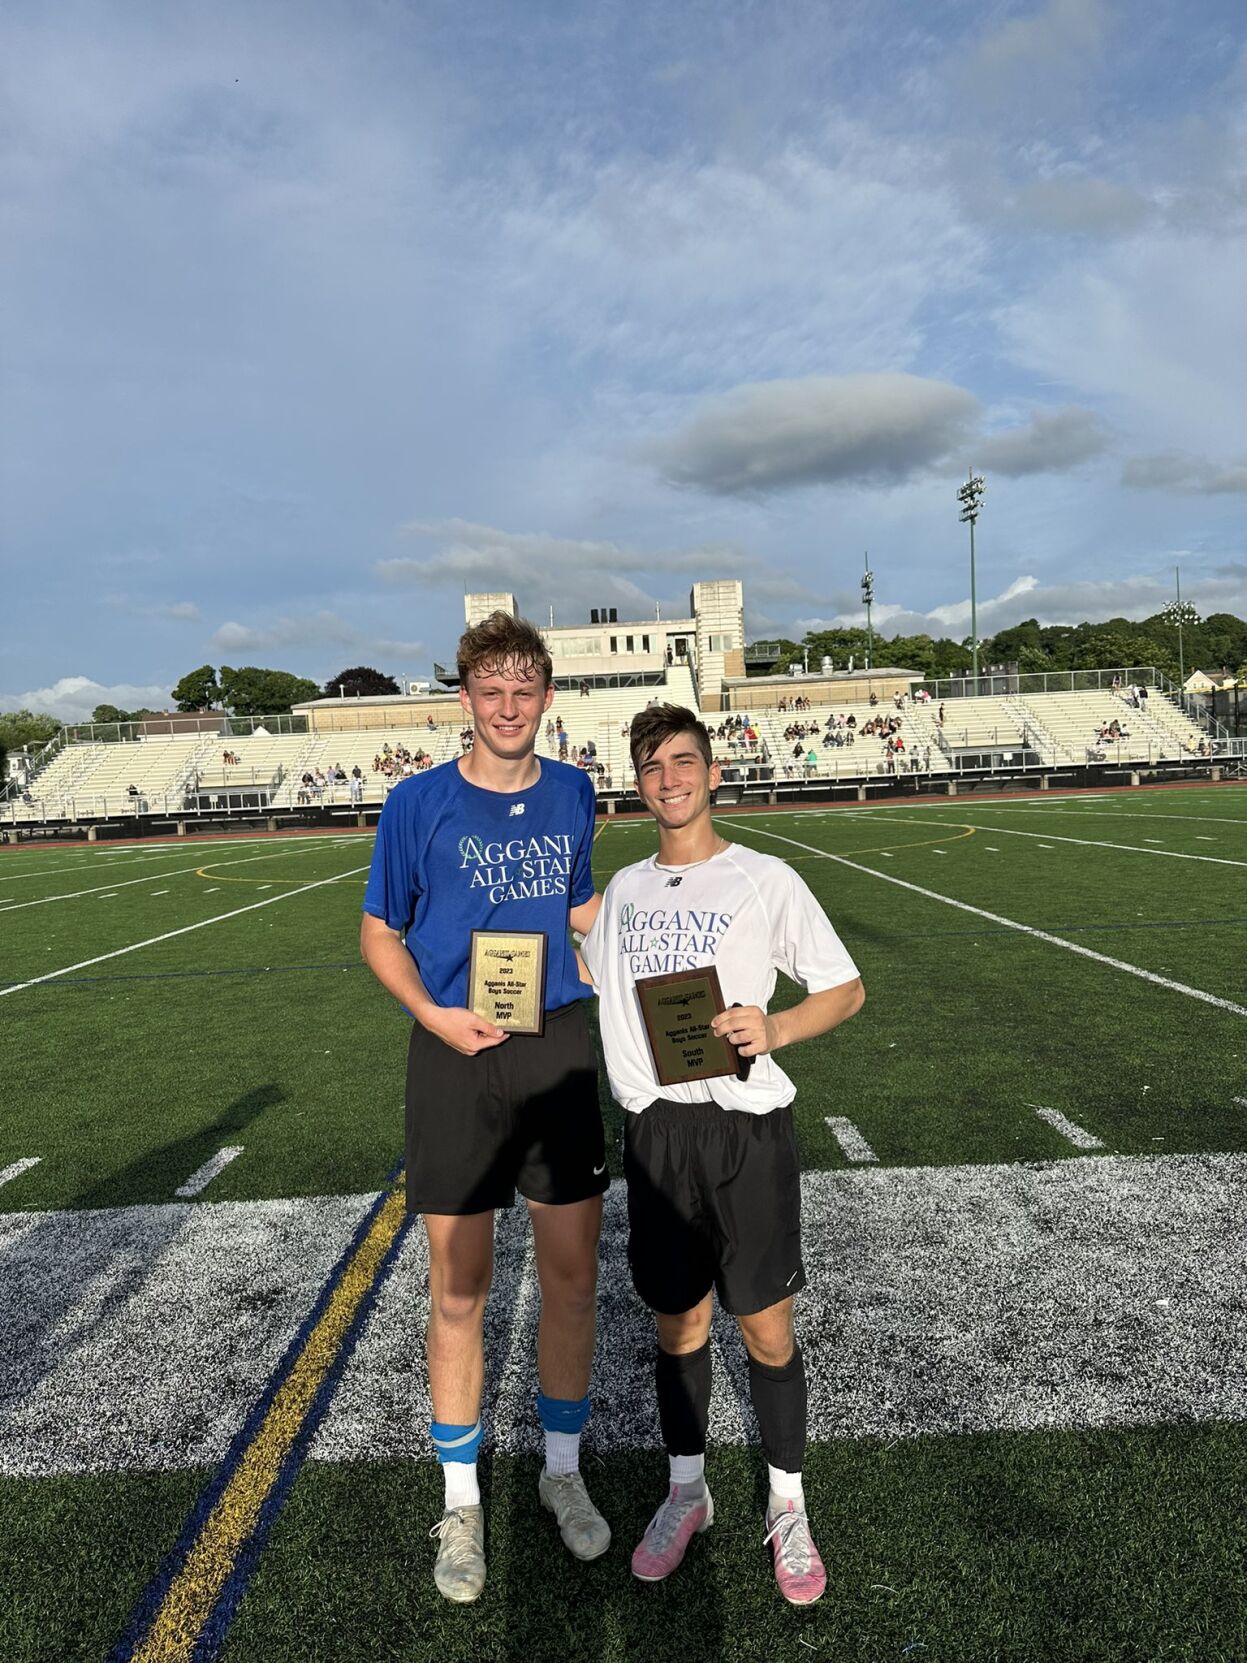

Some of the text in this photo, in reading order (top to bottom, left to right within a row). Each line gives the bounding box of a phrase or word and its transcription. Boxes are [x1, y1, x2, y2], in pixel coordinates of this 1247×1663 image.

[460, 835, 574, 868] AGGANI
[470, 866, 513, 888] ALL
[489, 877, 566, 904] GAMES
[618, 903, 732, 935] AGGANIS
[620, 933, 716, 955] ALL STAR
[630, 954, 697, 973] GAMES
[495, 1002, 514, 1010] North
[682, 1048, 704, 1057] South
[687, 1058, 704, 1067] MVP
